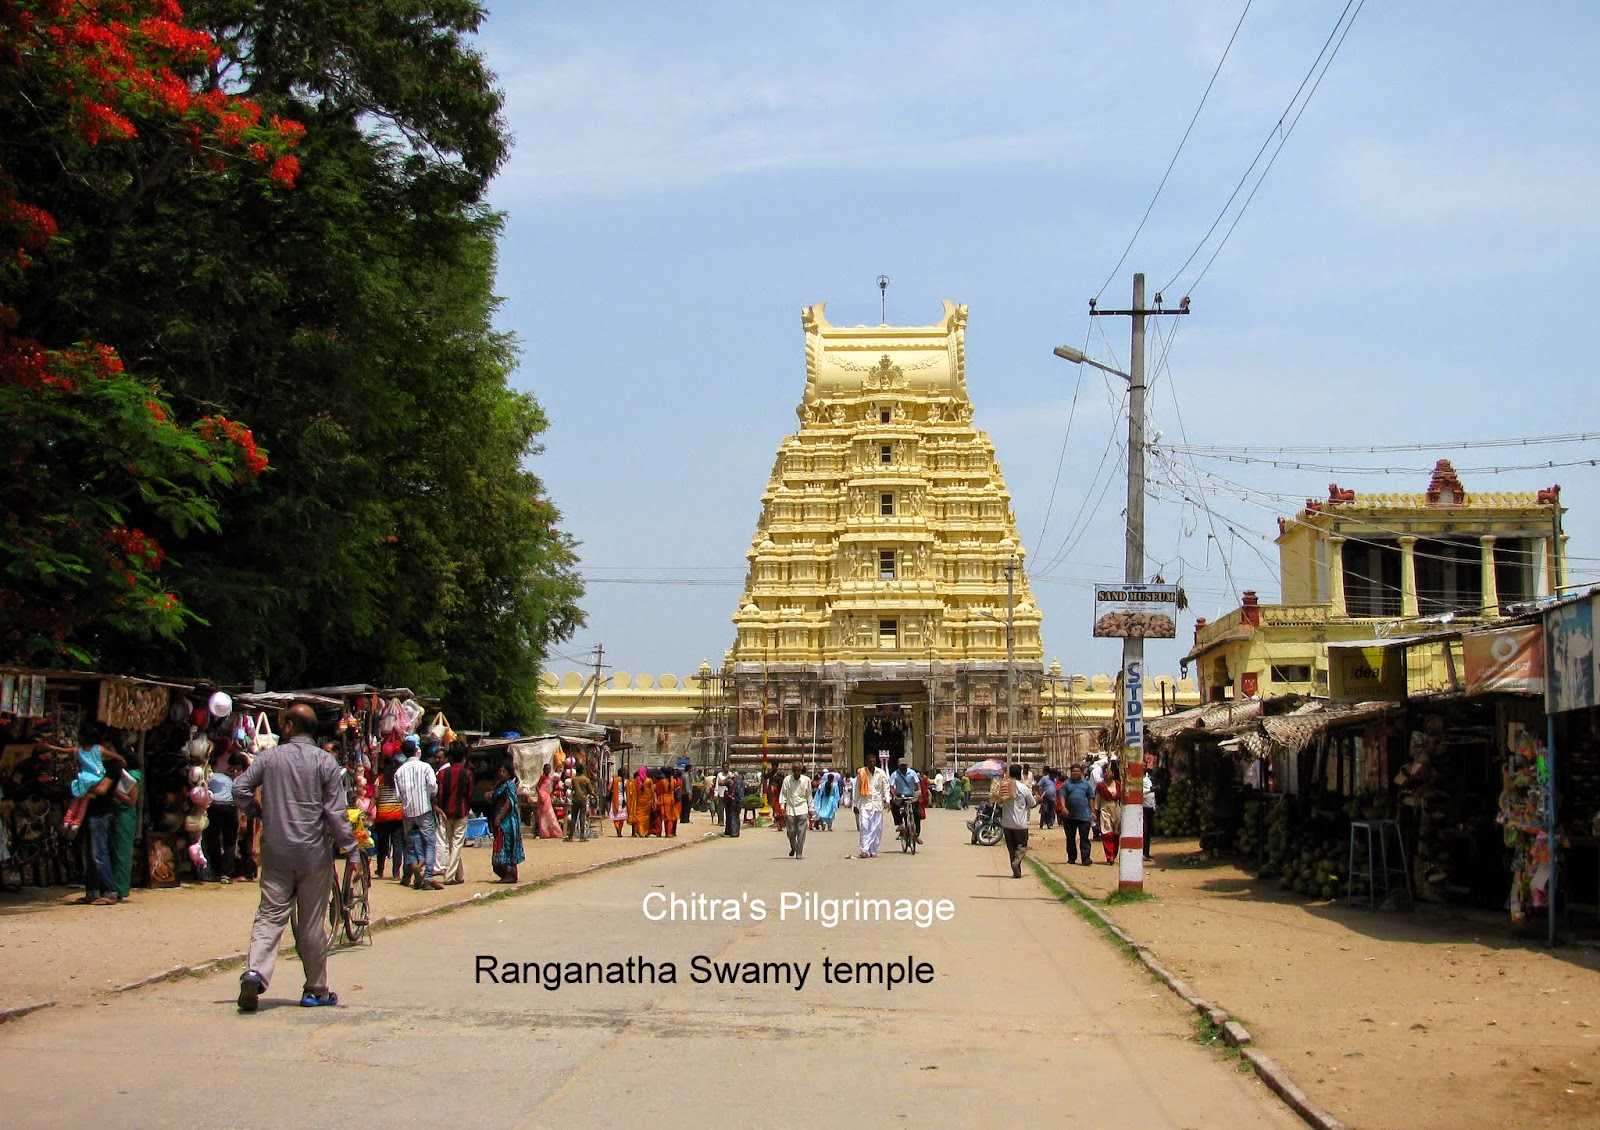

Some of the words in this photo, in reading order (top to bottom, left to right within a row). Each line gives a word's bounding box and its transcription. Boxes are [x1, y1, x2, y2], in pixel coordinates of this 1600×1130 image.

[1098, 591, 1127, 602] SAND
[1128, 592, 1176, 602] MUSEUM
[1351, 664, 1380, 679] dea
